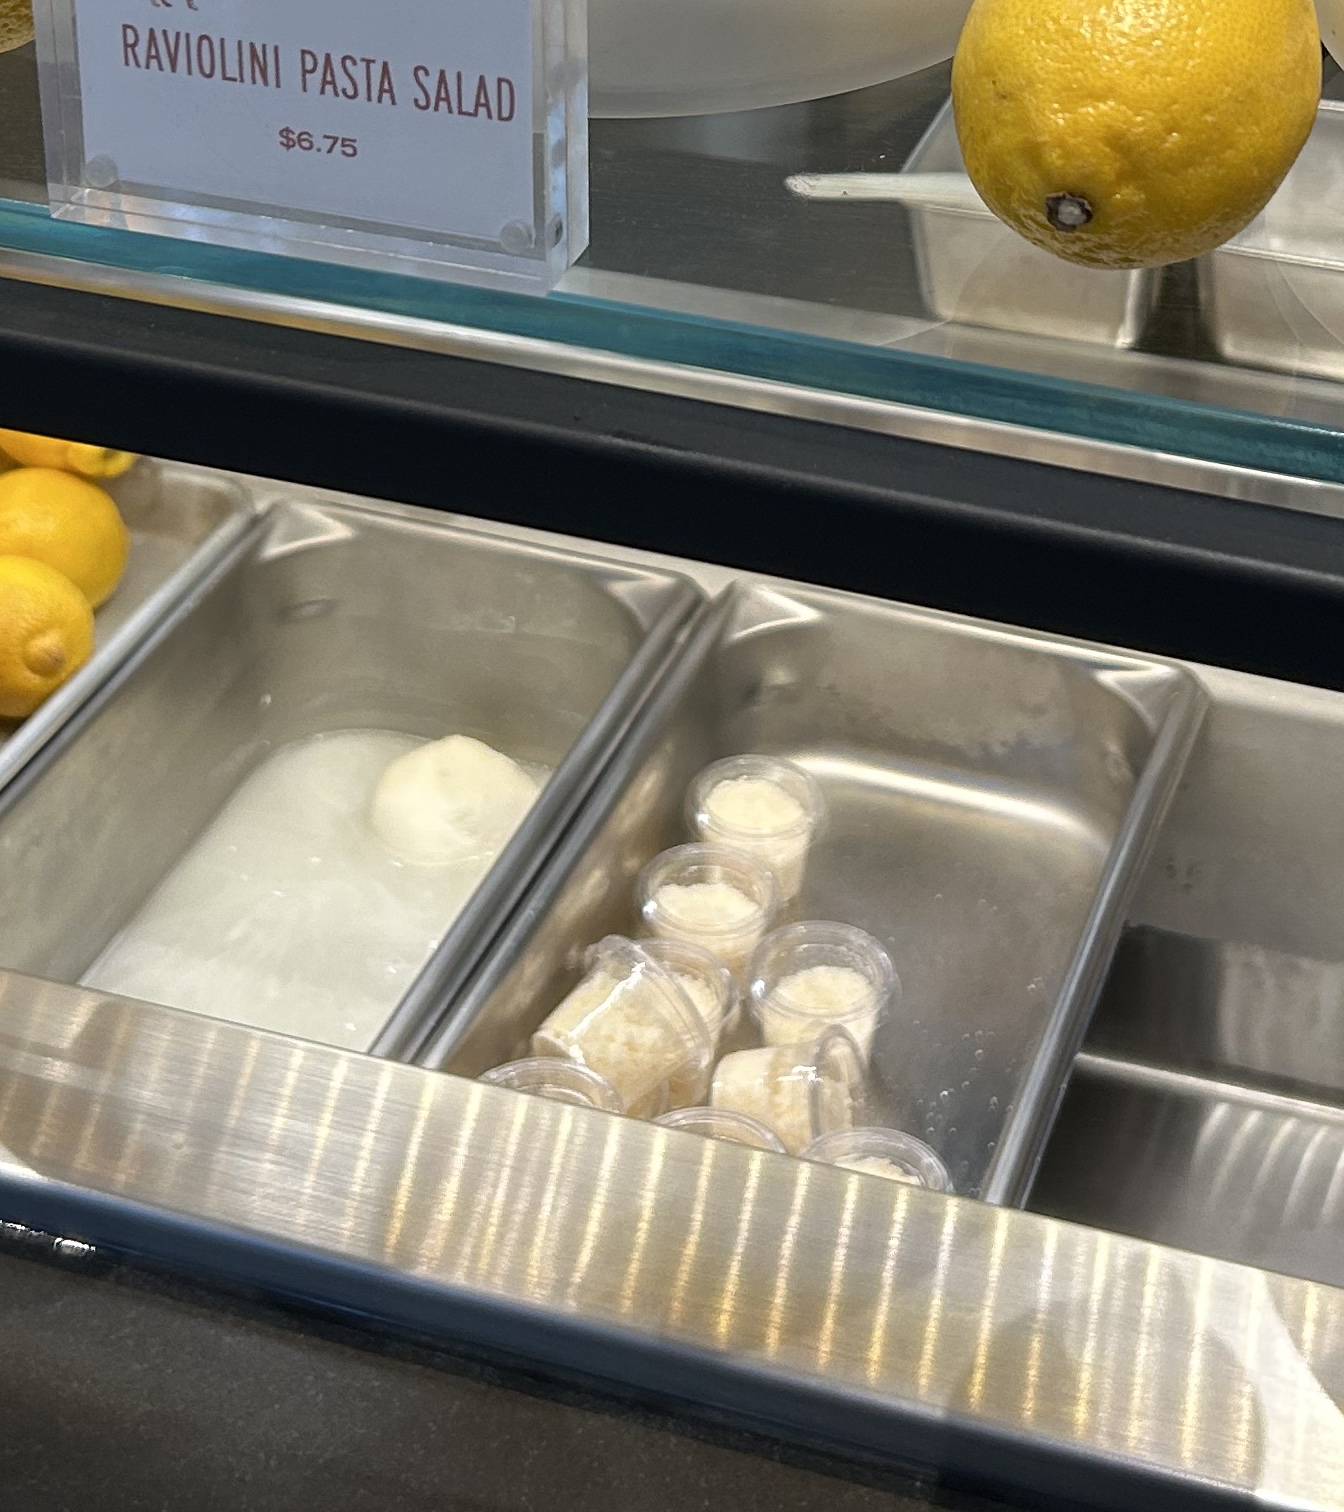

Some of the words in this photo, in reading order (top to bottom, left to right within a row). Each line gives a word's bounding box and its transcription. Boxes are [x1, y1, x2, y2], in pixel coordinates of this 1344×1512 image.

[122, 23, 282, 90] RAVIOLINI
[301, 48, 397, 107] PASTA
[413, 64, 516, 122] SALAD
[278, 126, 358, 158] $6.75
